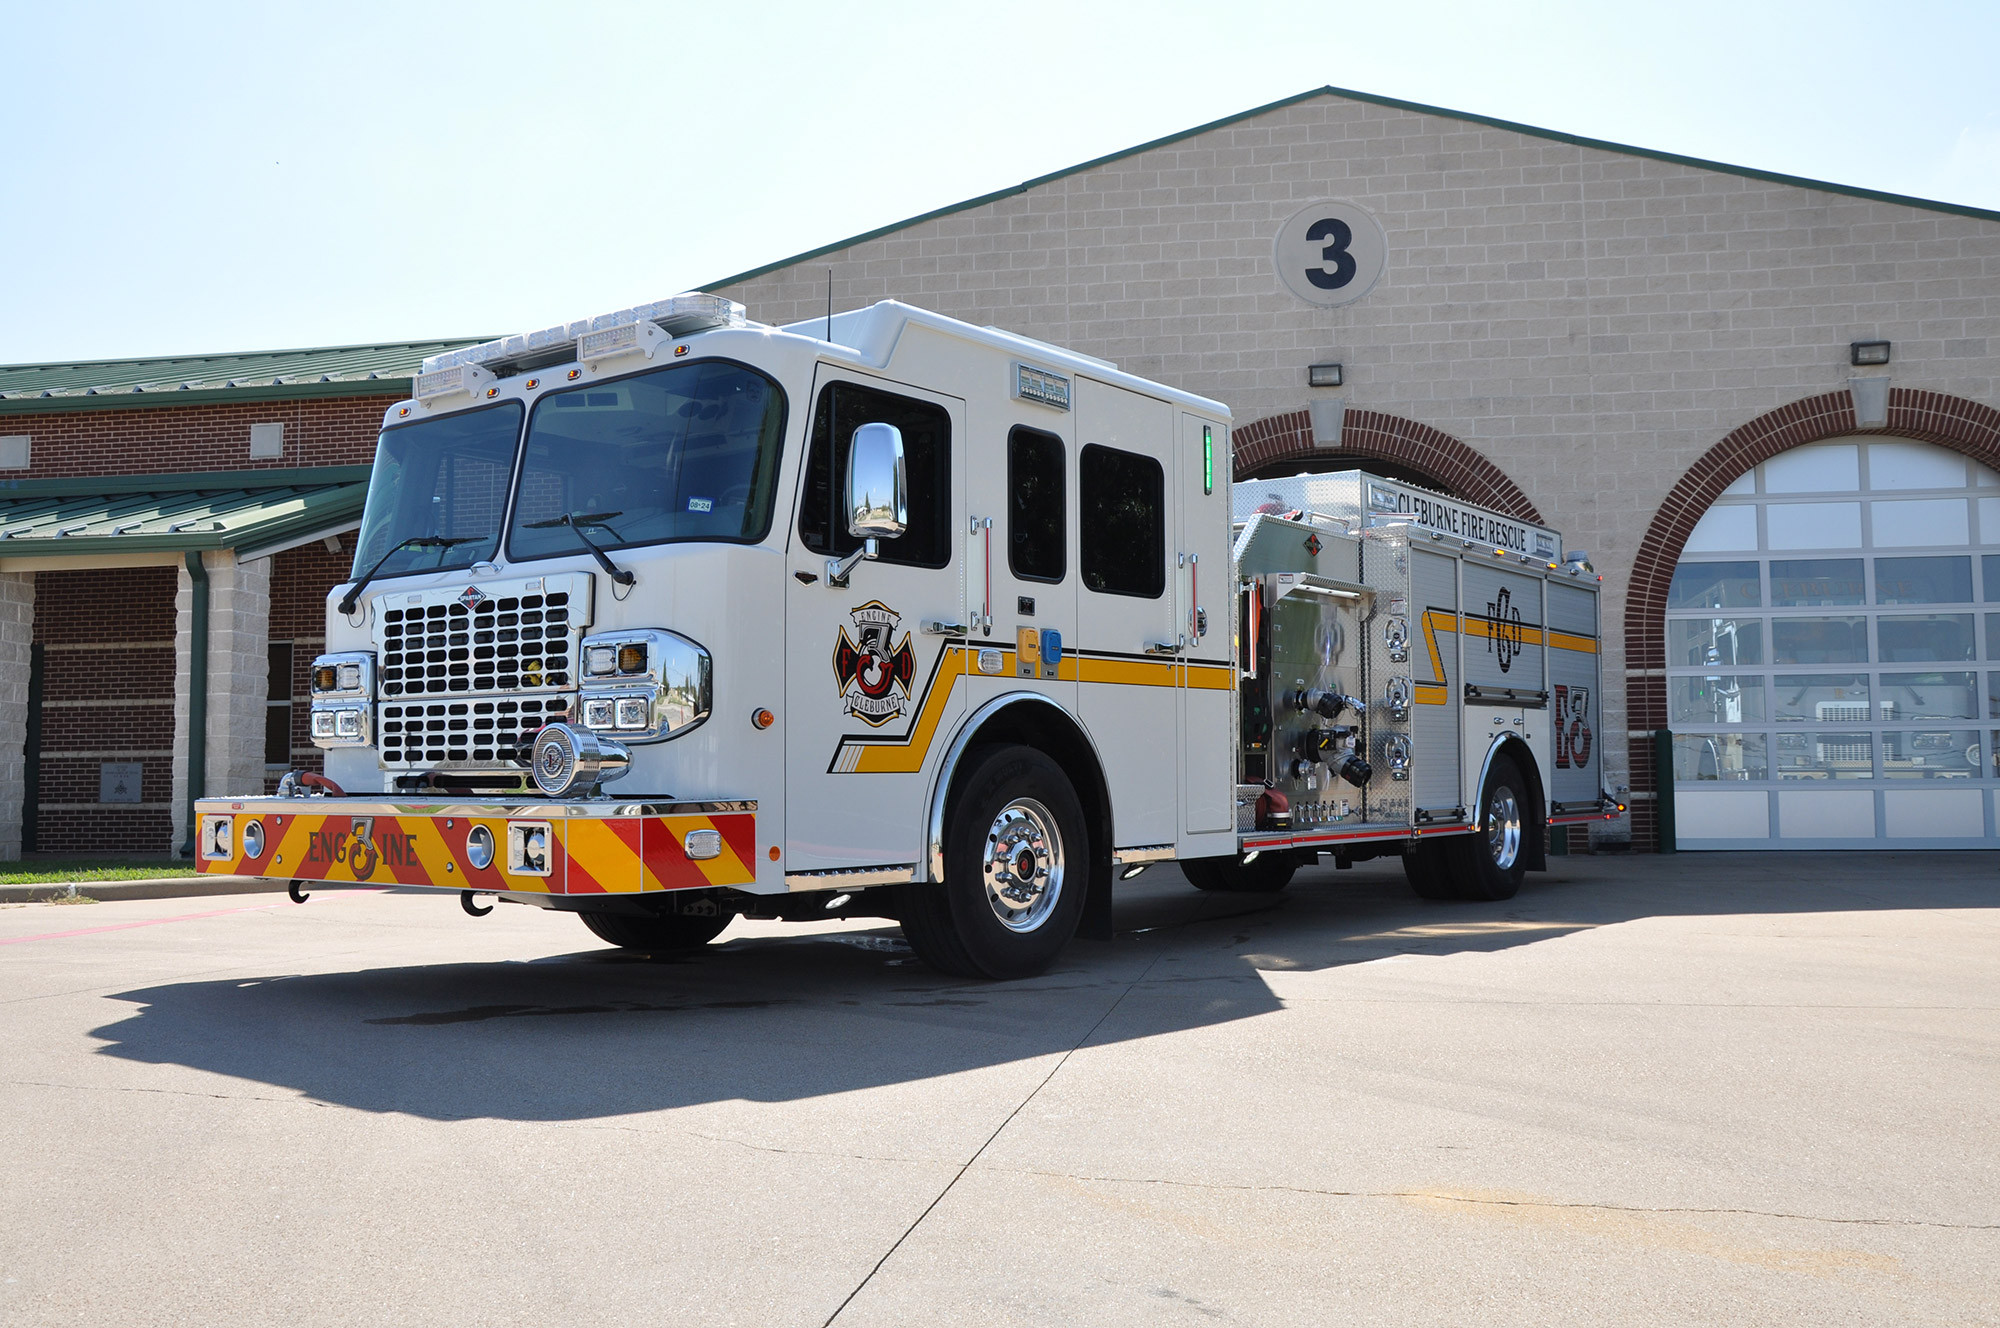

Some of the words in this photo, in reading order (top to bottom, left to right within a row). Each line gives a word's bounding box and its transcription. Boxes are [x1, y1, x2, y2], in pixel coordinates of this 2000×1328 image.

[1305, 217, 1357, 290] 3
[860, 610, 892, 622] ENGINE
[854, 695, 898, 713] CLEBURNE
